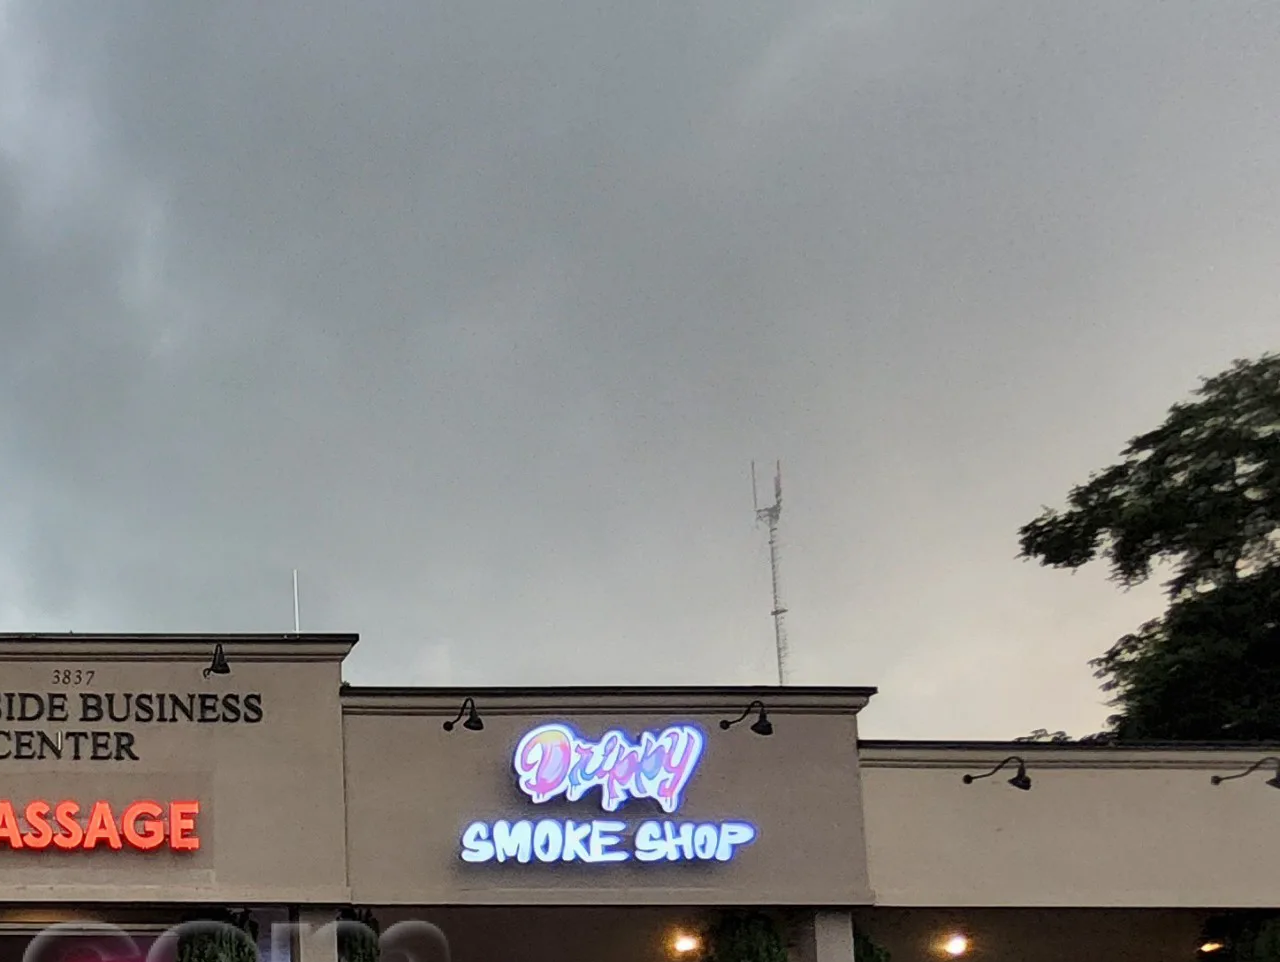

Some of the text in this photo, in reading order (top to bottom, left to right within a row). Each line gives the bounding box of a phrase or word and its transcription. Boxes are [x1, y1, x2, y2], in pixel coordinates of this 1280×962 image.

[52, 669, 95, 686] 3837
[80, 692, 263, 724] BUSINESS
[460, 820, 756, 864] SMOKE SHOP
